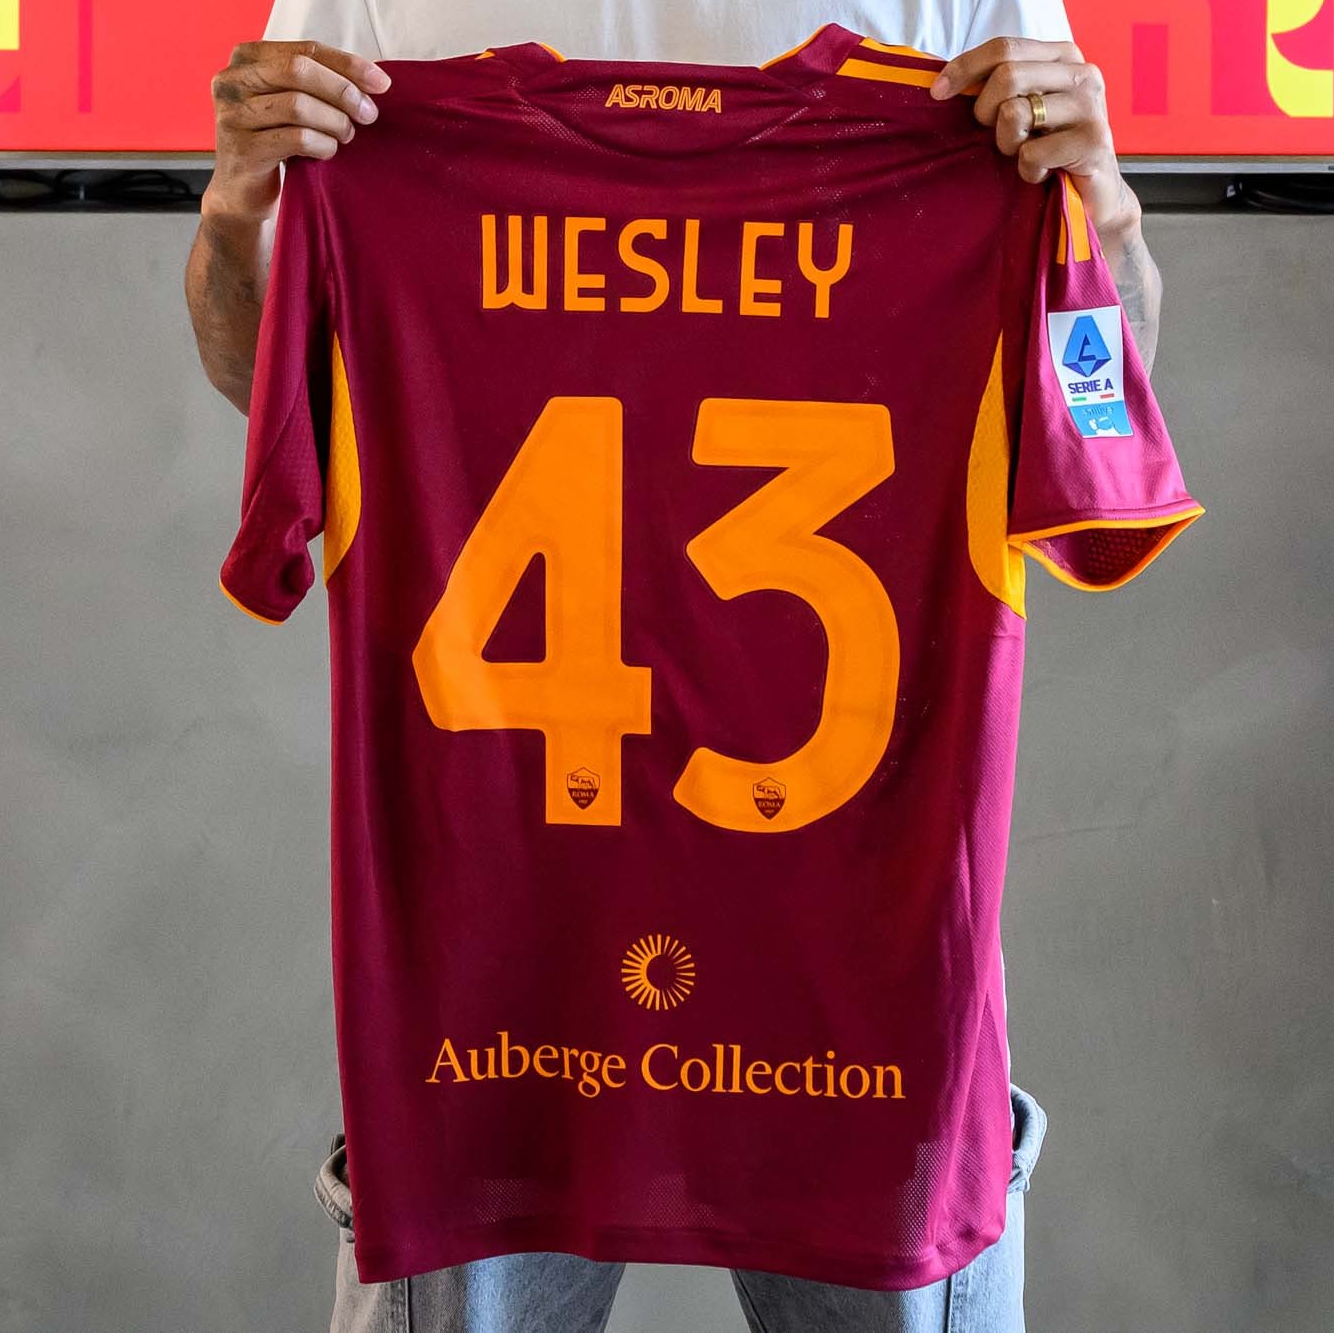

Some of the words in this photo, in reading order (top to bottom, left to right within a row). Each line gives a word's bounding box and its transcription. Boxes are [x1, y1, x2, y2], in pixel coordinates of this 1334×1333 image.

[481, 213, 854, 319] WESLEY
[1068, 379, 1102, 394] SERIE
[1104, 378, 1114, 391] A
[412, 396, 901, 833] 43
[425, 1031, 627, 1098] Auberge
[641, 1043, 907, 1099] Collection
